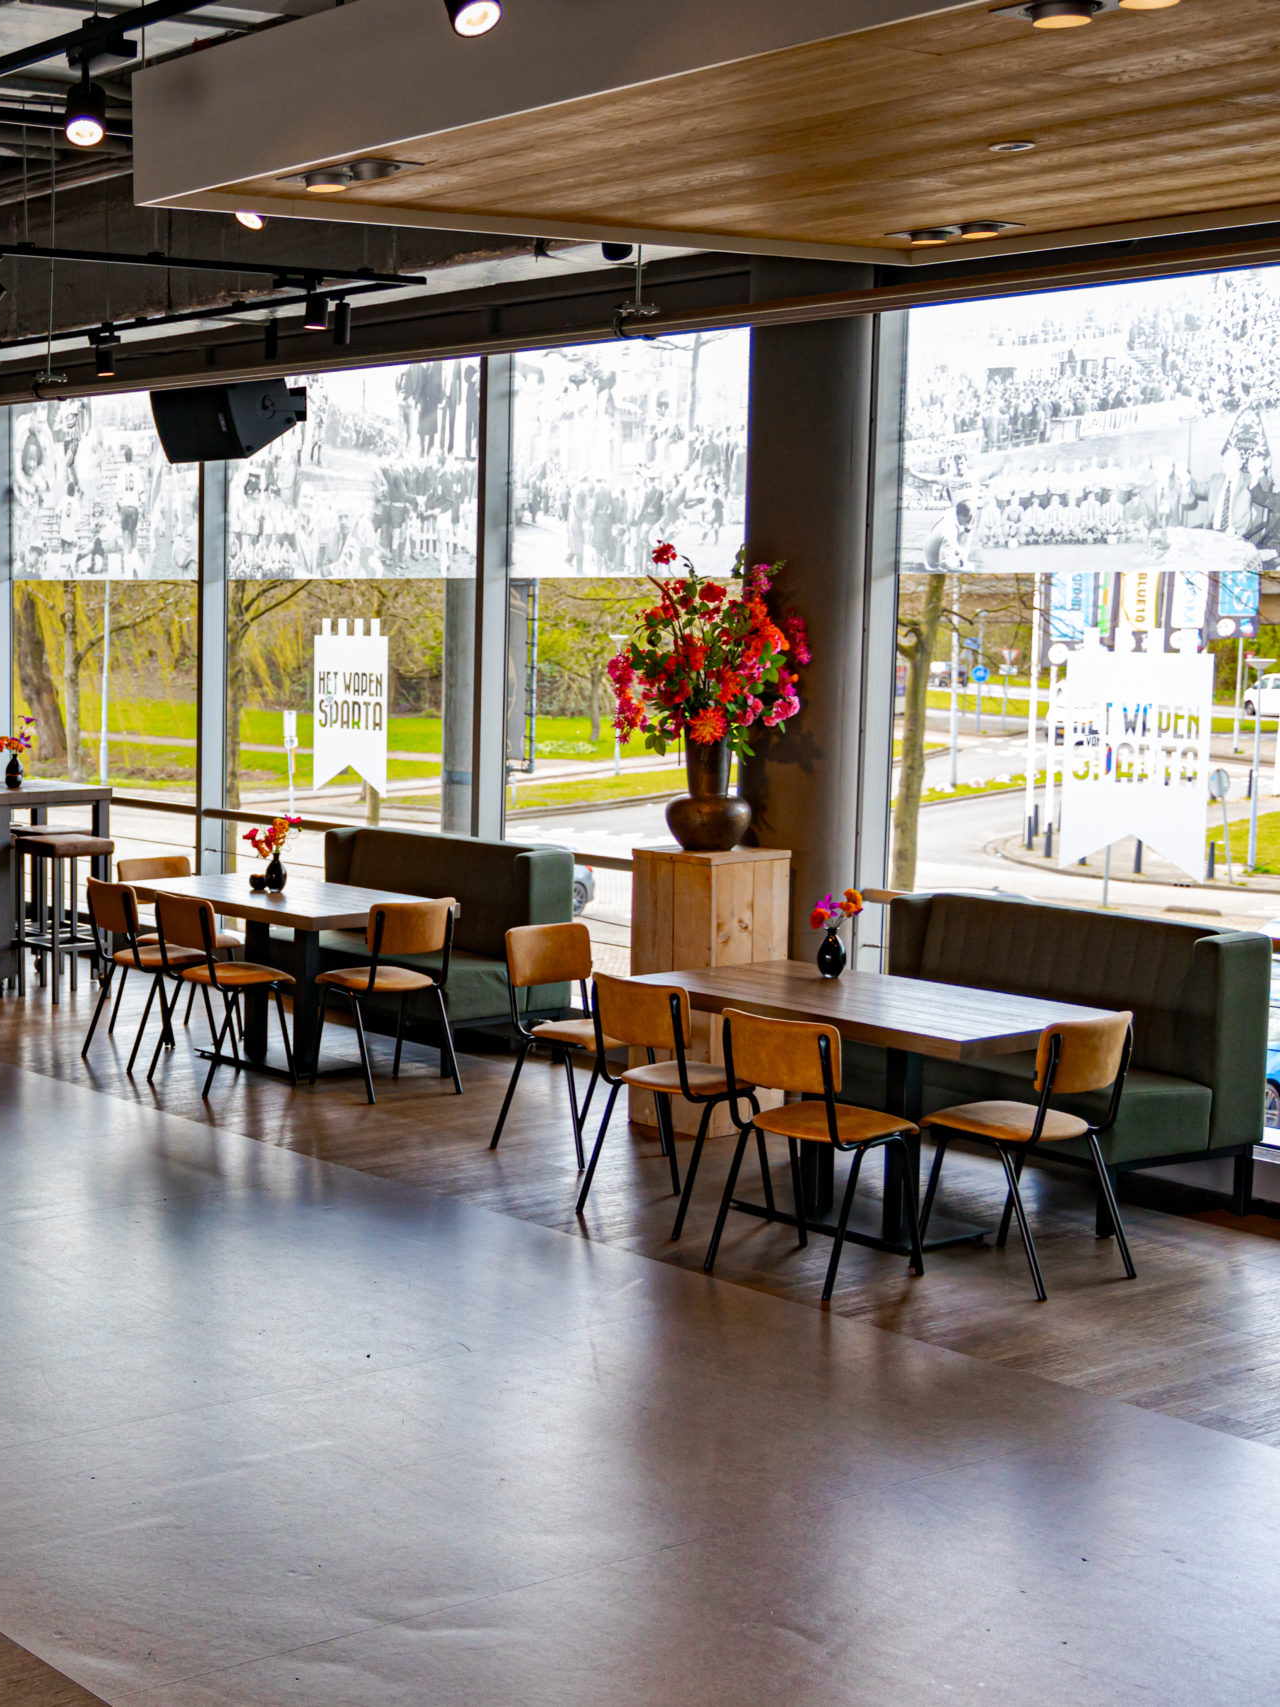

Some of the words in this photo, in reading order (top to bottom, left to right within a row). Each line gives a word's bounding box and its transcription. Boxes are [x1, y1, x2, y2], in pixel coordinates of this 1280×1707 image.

[318, 671, 338, 695] HET
[343, 671, 383, 697] WAPEN
[318, 699, 383, 731] SPARTA
